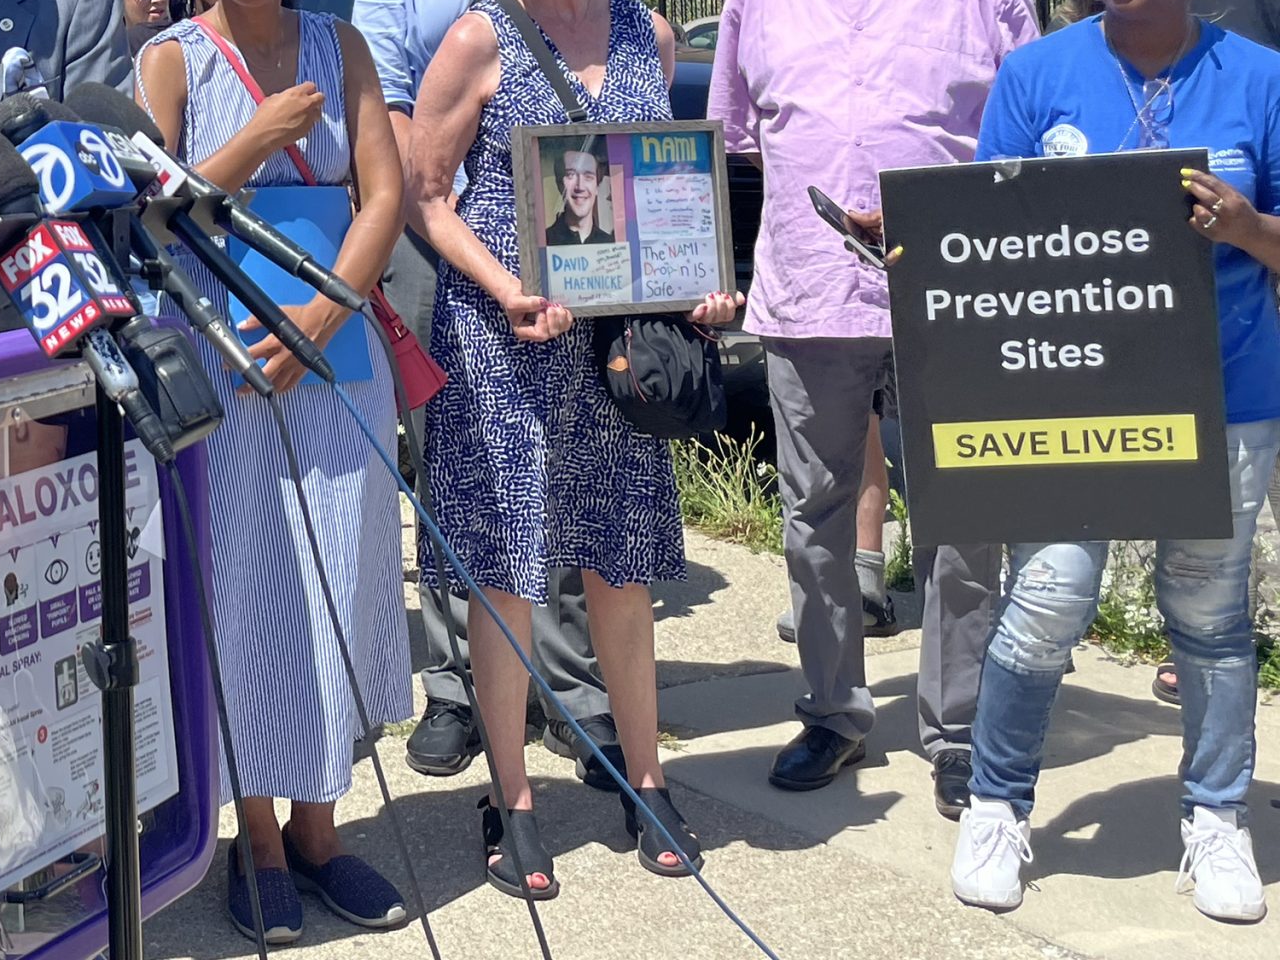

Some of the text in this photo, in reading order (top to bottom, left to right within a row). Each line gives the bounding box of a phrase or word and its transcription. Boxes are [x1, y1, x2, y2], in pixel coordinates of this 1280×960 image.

[54, 224, 88, 247] FOX
[641, 246, 666, 261] The
[668, 242, 698, 259] NAMI
[940, 224, 1150, 264] Overdose
[1, 232, 53, 285] FOX
[73, 252, 118, 294] 32
[552, 254, 589, 273] DAVID
[20, 262, 83, 330] 32
[564, 276, 623, 291] HAENNICKE
[646, 280, 675, 299] Safe
[925, 278, 1174, 321] Prevention
[102, 298, 130, 310] NEWS
[45, 305, 96, 349] NEWS
[1000, 338, 1105, 371] Sites
[956, 426, 1175, 459] SAVE LIVES!
[13, 651, 42, 673] SPRAY:
